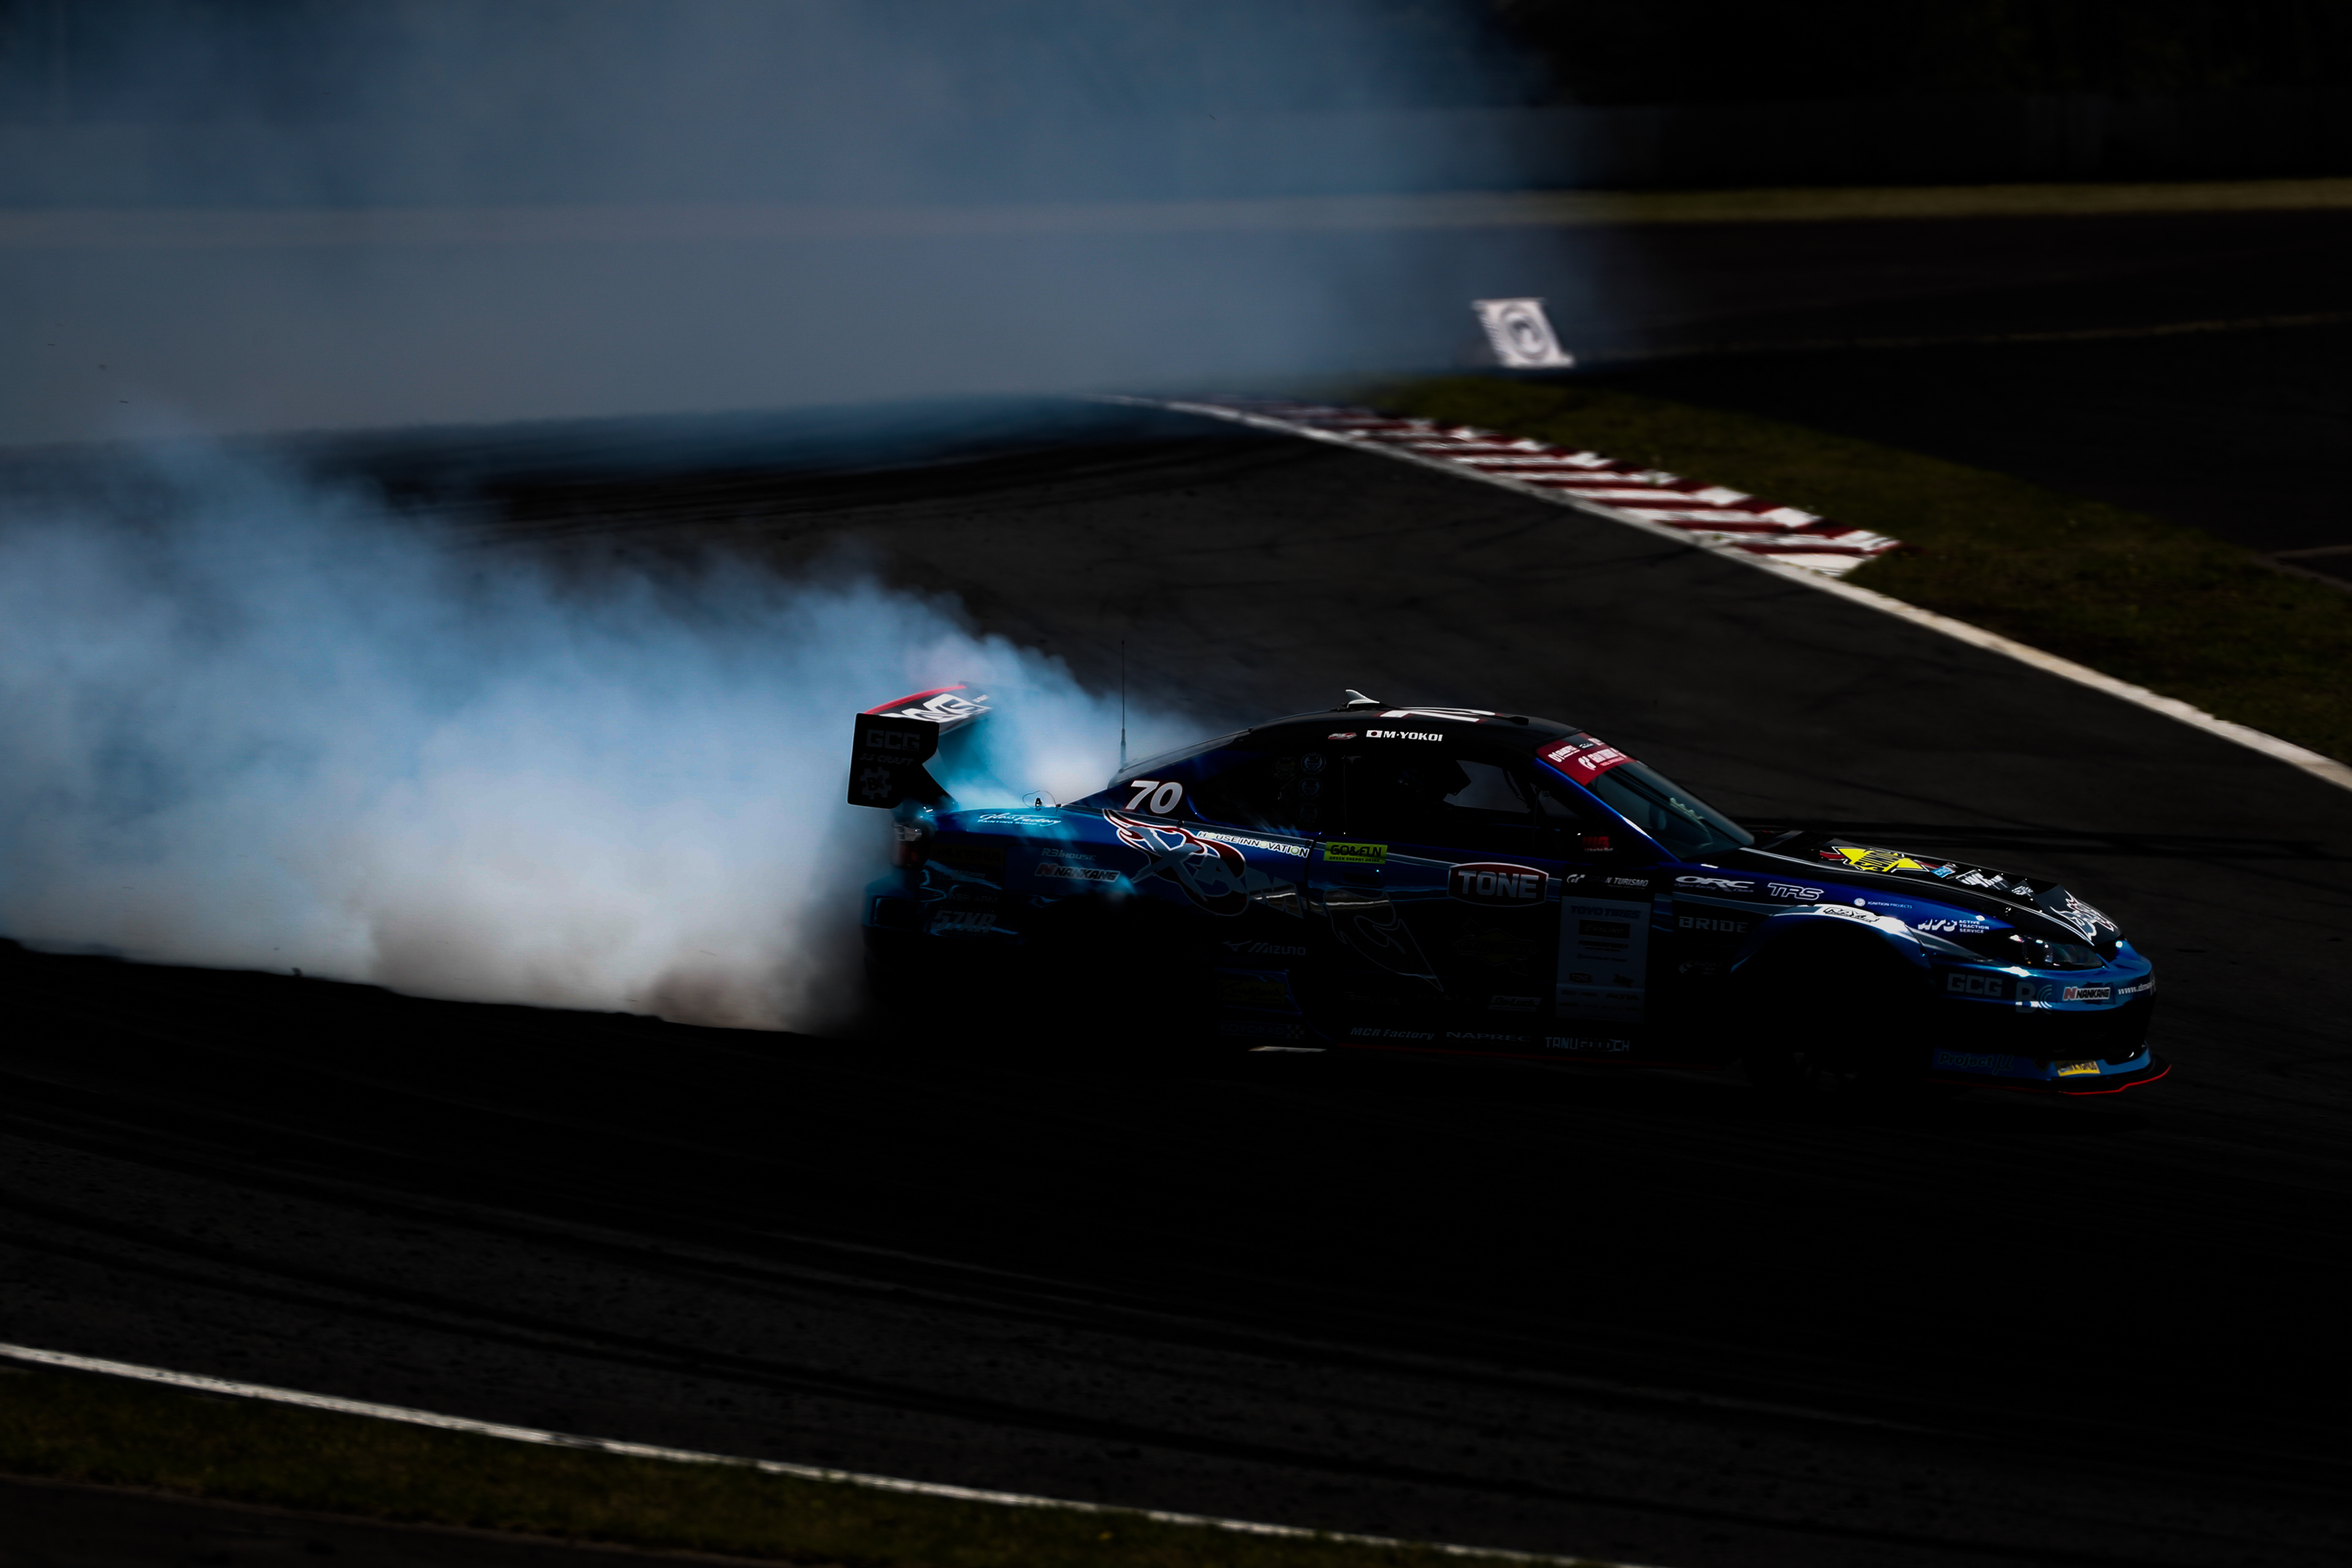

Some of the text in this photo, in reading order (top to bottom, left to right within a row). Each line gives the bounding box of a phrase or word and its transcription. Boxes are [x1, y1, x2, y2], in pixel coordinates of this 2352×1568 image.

[1125, 780, 1184, 815] 70
[1458, 870, 1539, 899] TONE
[1613, 877, 1649, 887] TURISMO
[1767, 882, 1825, 900] TRS
[1571, 905, 1642, 919] TOYO TIRES
[1678, 916, 1749, 933] BRIDE
[1947, 973, 2002, 997] GCG
[1350, 1027, 1436, 1041] MCR Factory
[1446, 1031, 1532, 1042] NAPREC
